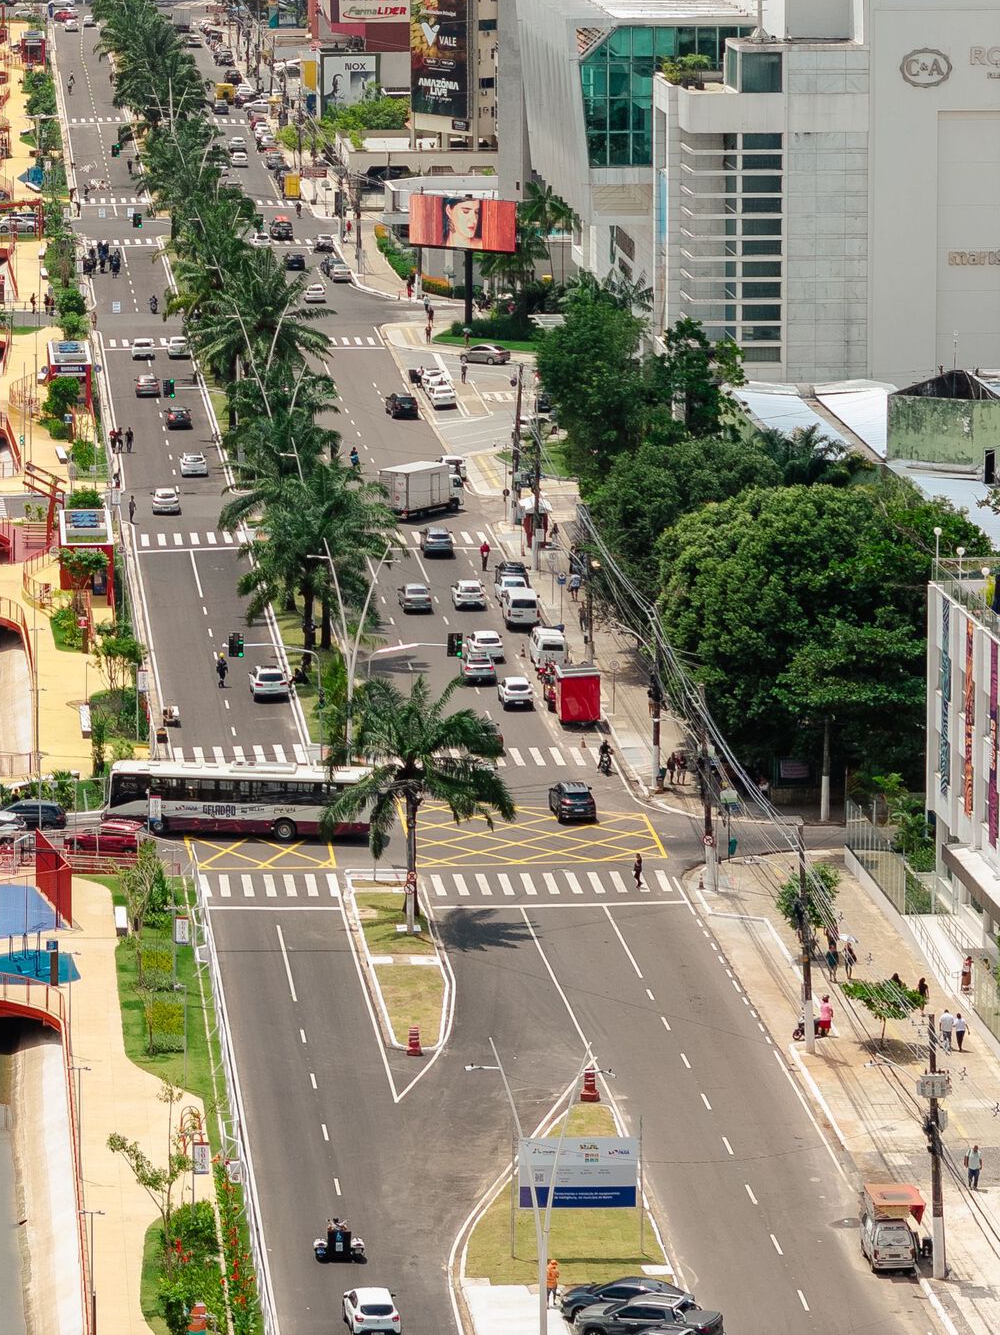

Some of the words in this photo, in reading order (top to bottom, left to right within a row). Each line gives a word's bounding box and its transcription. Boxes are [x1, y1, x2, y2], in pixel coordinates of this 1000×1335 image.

[439, 36, 457, 46] VALE
[345, 62, 367, 71] NOX
[905, 59, 945, 77] C&A
[418, 77, 459, 90] AMAZÔNIA
